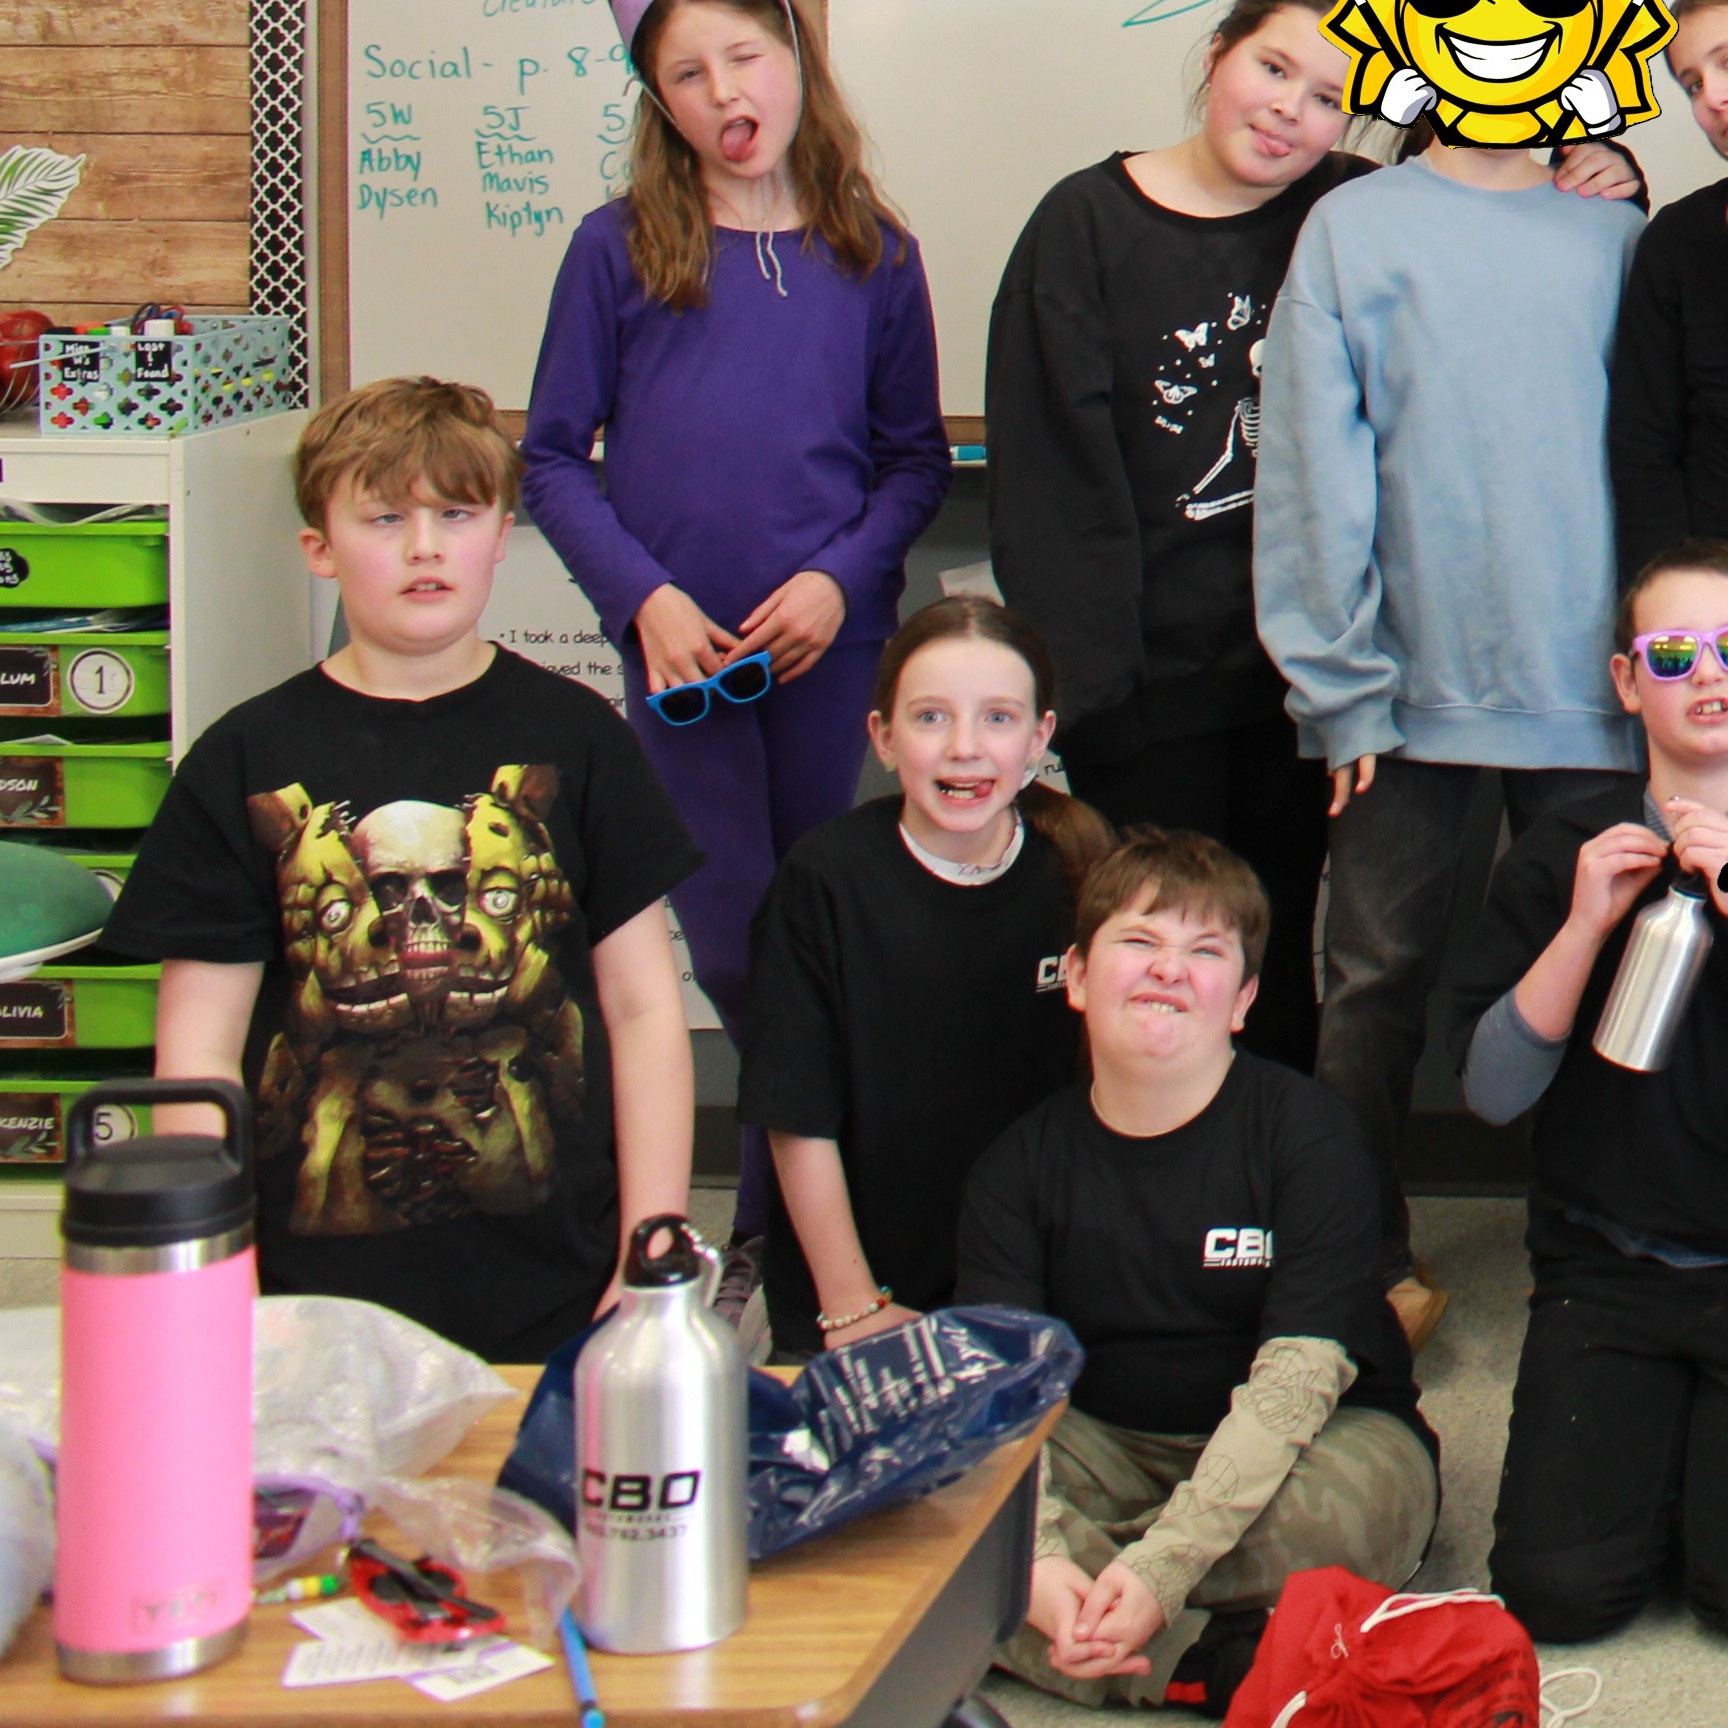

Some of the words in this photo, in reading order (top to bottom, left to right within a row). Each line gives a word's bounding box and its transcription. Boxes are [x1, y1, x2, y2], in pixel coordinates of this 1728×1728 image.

[364, 44, 472, 81] Social
[359, 148, 422, 182] Abby
[475, 141, 554, 170] Ethan
[357, 184, 438, 219] Dysen
[482, 172, 550, 196] Mavis
[524, 630, 554, 644] took
[559, 634, 568, 644] a
[94, 665, 105, 694] 1
[582, 1469, 701, 1510] CBO
